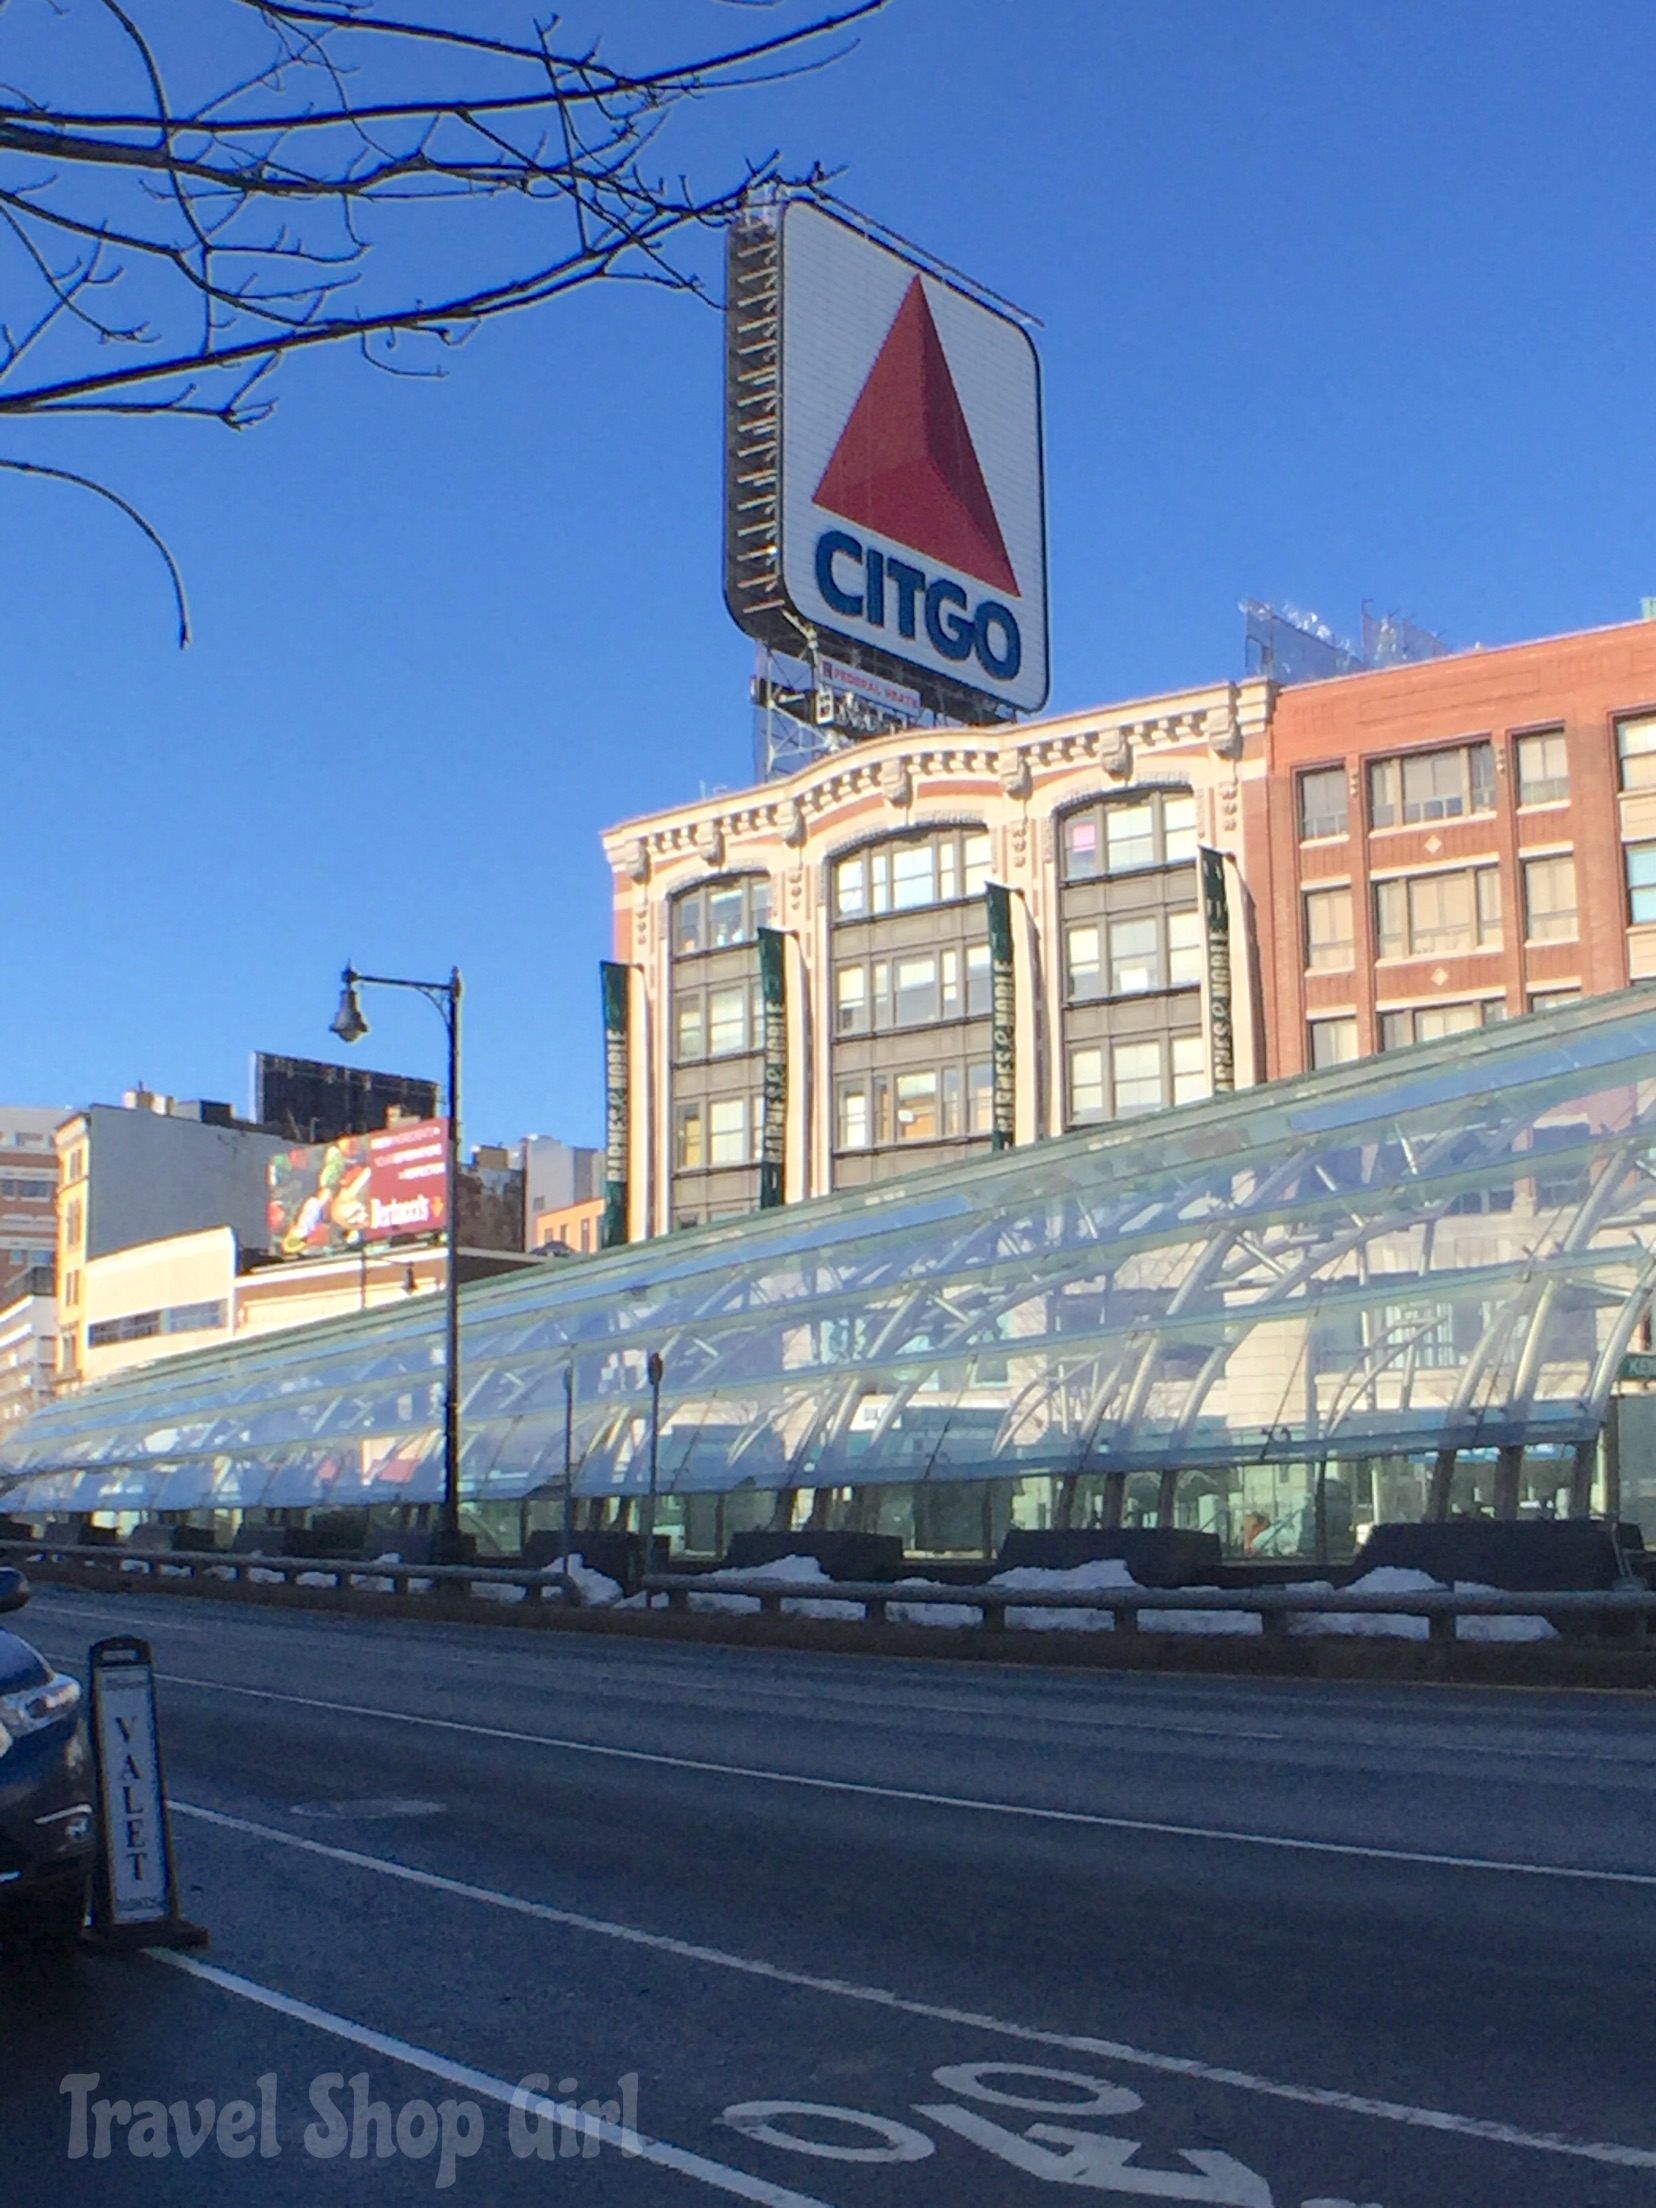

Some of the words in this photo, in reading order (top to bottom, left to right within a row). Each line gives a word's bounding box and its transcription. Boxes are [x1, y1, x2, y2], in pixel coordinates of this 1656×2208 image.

[815, 530, 1021, 681] CITGO
[993, 960, 1014, 1026] NOBLE
[606, 1029, 627, 1088] NOBLE
[993, 1051, 1014, 1132] BARNES
[1213, 1022, 1233, 1092] ARNES
[607, 1109, 627, 1182] BARNES
[763, 1086, 785, 1163] BARNES
[115, 1716, 145, 1881] VALET
